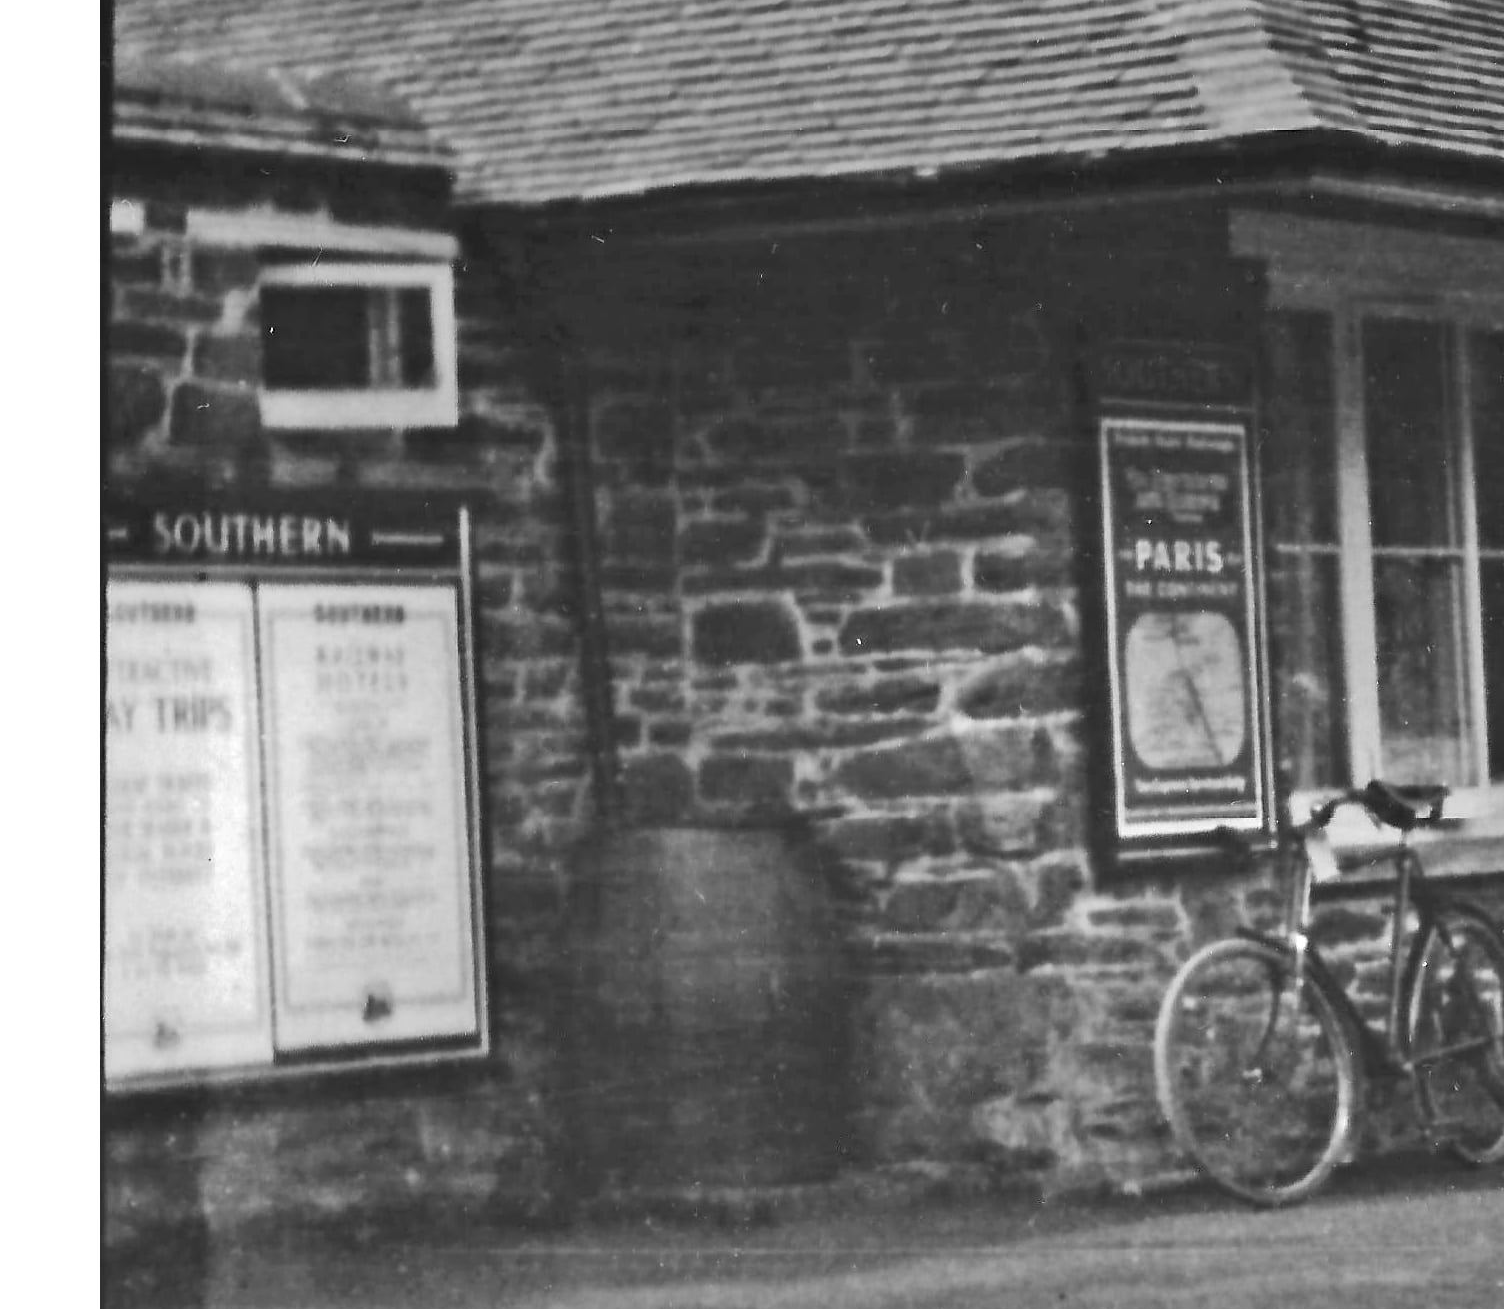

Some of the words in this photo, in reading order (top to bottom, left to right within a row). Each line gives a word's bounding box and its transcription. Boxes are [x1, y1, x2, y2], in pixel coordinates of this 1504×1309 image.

[153, 511, 350, 554] SOUTHERN
[1134, 538, 1223, 572] PARIS
[109, 603, 196, 623] OUTHERN
